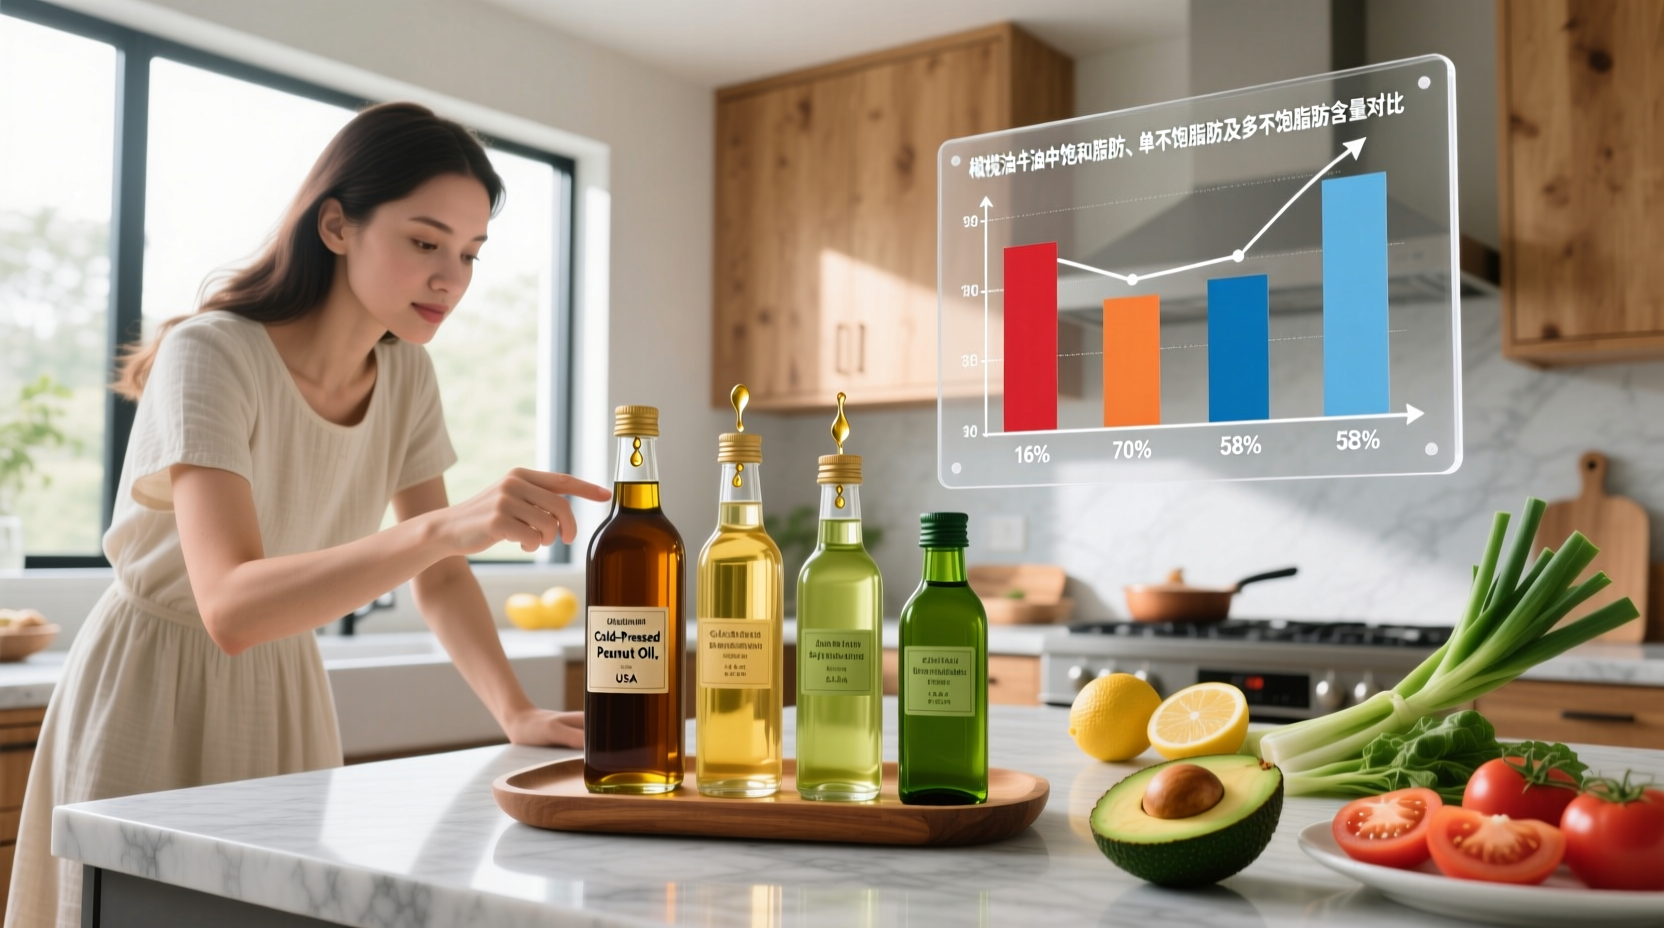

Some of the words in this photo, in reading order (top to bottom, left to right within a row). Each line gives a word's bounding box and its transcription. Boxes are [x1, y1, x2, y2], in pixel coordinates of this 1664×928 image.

[1015, 444, 1050, 464] 16%
[1113, 440, 1152, 459] 70%
[1220, 435, 1261, 455] 58%
[1336, 429, 1381, 450] 58%
[616, 673, 638, 684] USA
